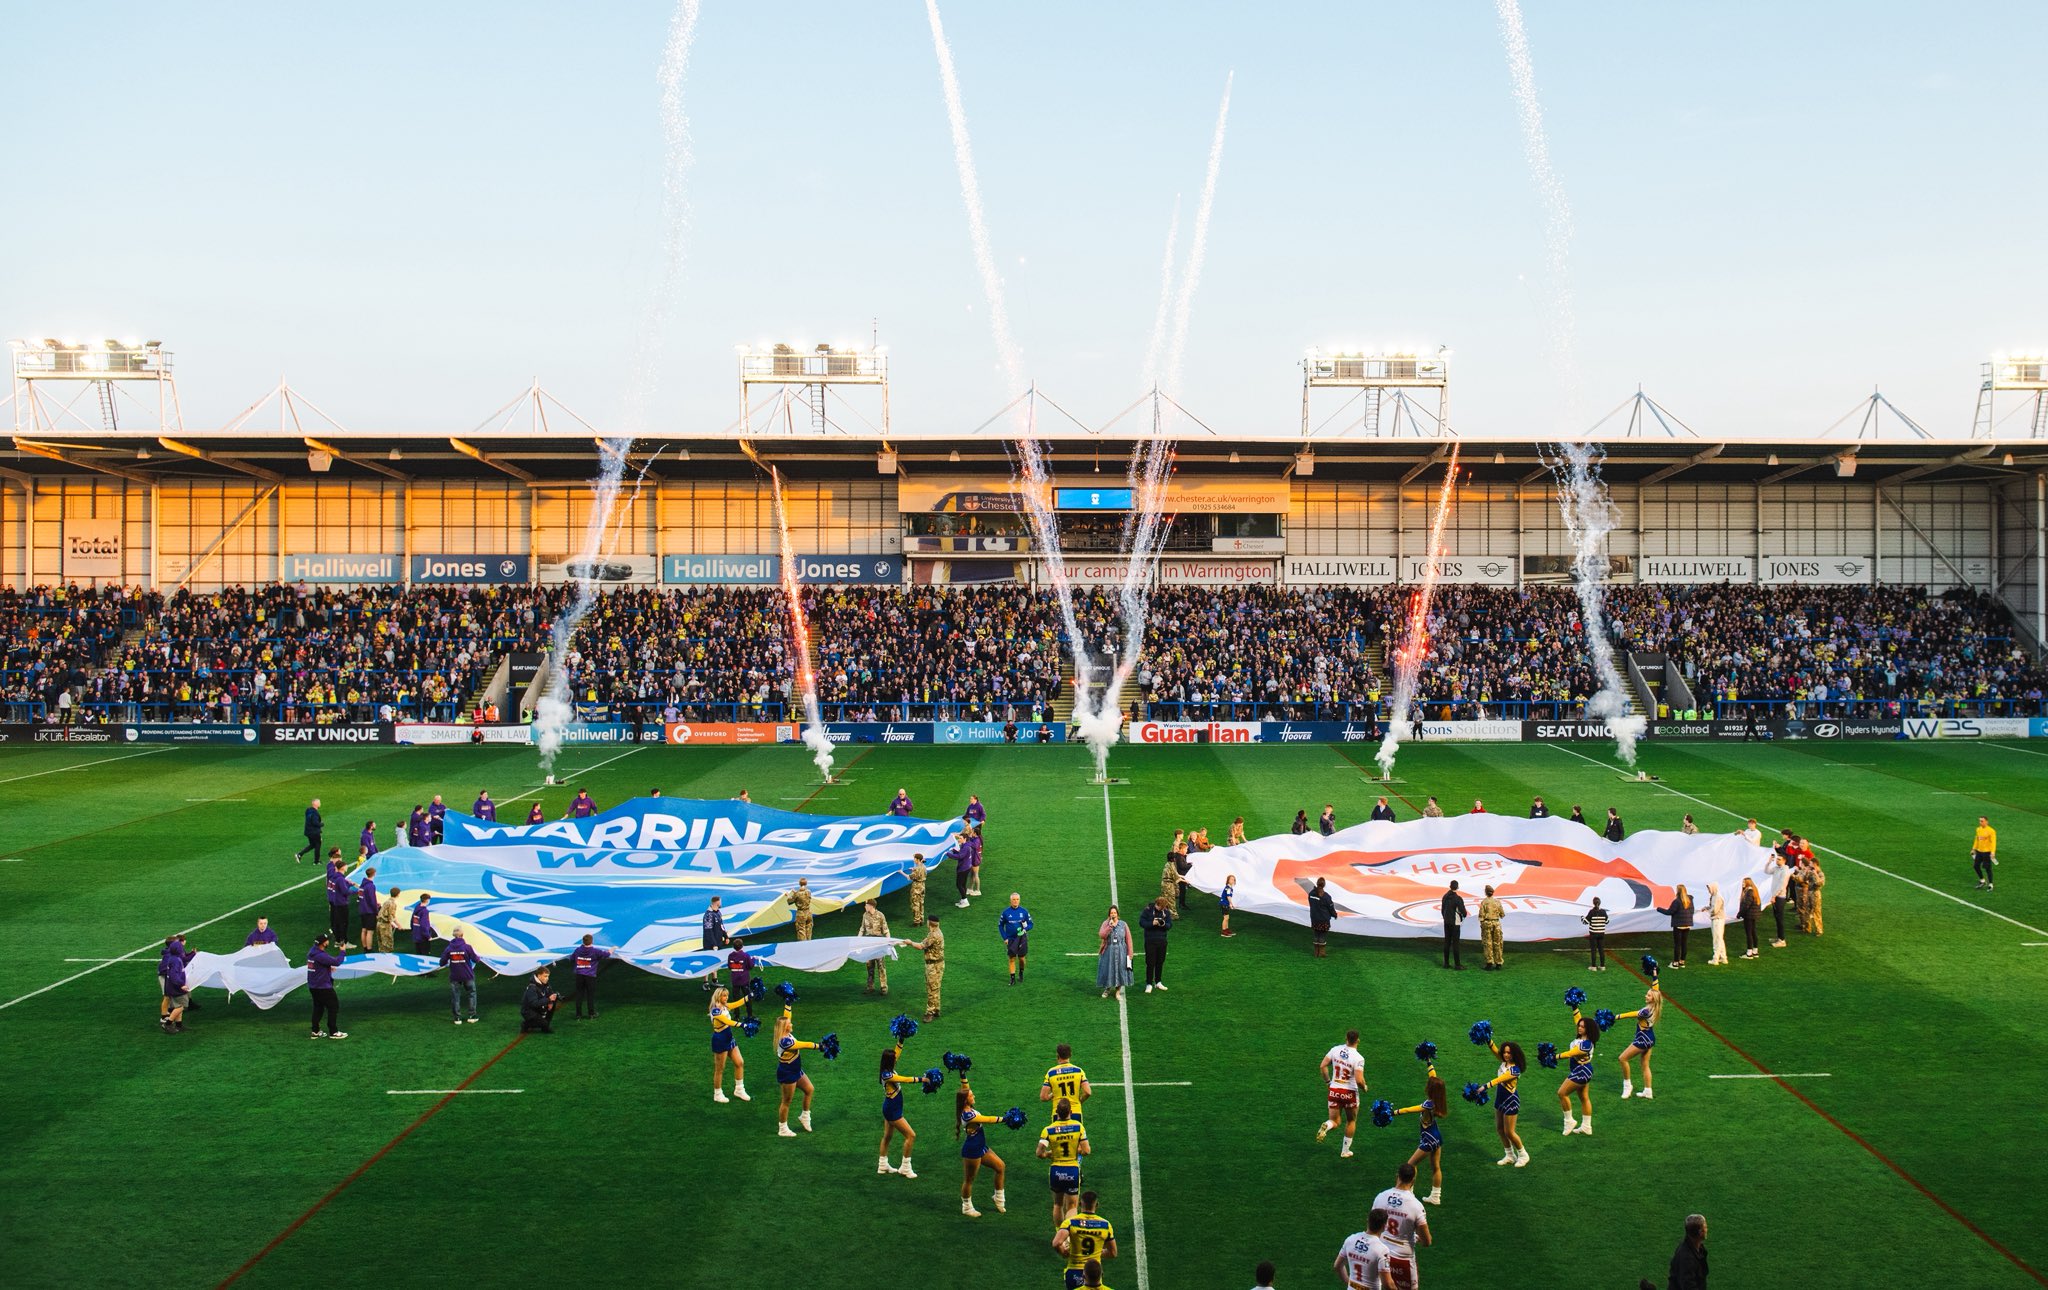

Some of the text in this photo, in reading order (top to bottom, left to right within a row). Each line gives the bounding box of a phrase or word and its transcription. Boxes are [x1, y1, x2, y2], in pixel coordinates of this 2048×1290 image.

[1155, 494, 1275, 504] w.chester.ac.uk/warrington
[68, 535, 118, 554] Total
[294, 558, 487, 579] Halliwell Jones
[674, 559, 861, 580] Halliwell Jones
[1045, 563, 1080, 578] Yur
[1164, 563, 1178, 578] in
[1182, 563, 1272, 581] Warrington
[1291, 562, 1390, 576] HALLIWELL
[1648, 562, 1820, 580] HALLIWELL JONES
[34, 732, 111, 742] UK Lift Escalator
[274, 727, 380, 743] SEAT UNIQUE
[466, 730, 505, 739] MERN.
[559, 728, 617, 741] Halliwell
[969, 728, 1055, 740] Halliw Jons
[1342, 723, 1366, 743] HOOV
[1456, 723, 1518, 735] Solicitors
[1536, 725, 1615, 739] SEAT UNIQ
[1845, 725, 1901, 736] Ryders Hyundai
[462, 813, 965, 851] WARRINGTON
[536, 849, 860, 874] WOLVES
[1334, 1065, 1351, 1081] 13
[1058, 1081, 1076, 1097] 11
[1060, 1141, 1069, 1157] 1
[1388, 1217, 1399, 1236] 8
[1081, 1236, 1095, 1256] 9
[1354, 1263, 1363, 1281] 1
